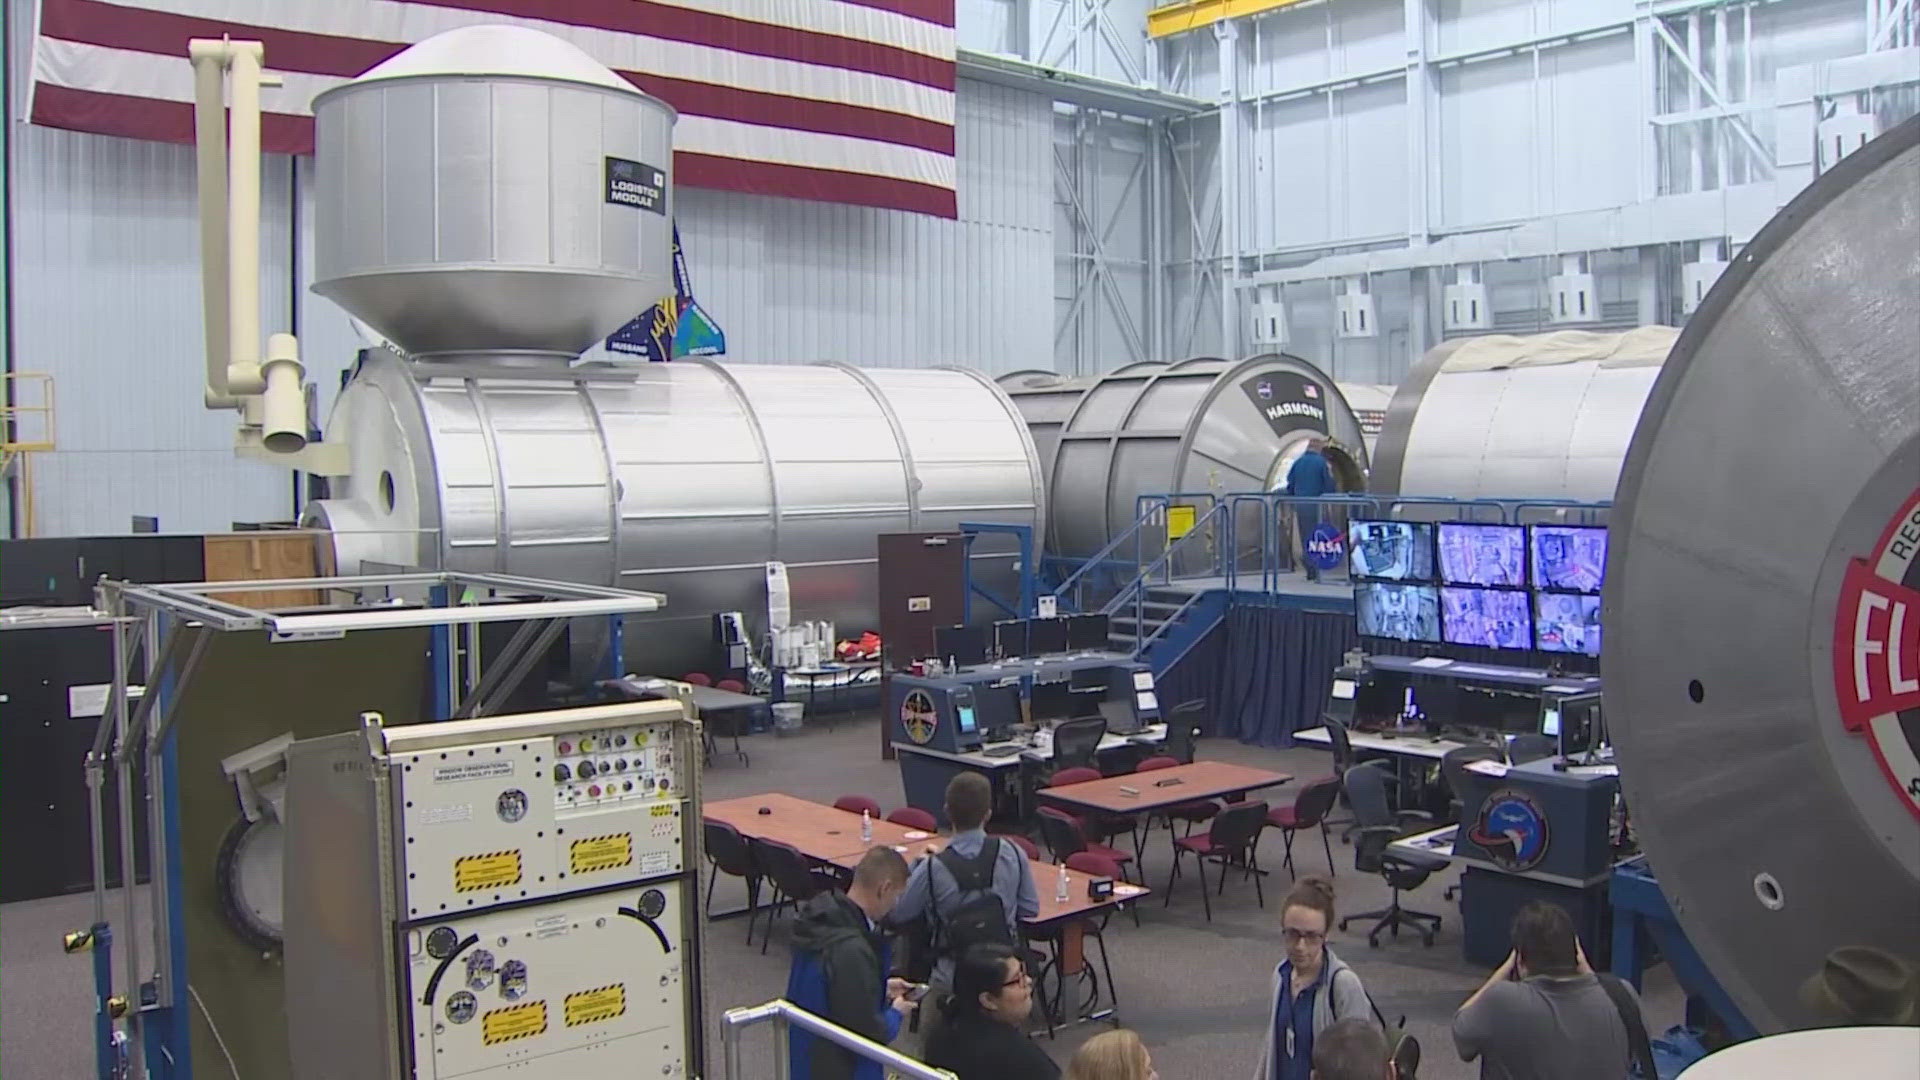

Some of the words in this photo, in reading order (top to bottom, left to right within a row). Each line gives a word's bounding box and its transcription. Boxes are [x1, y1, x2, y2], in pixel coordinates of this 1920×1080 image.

[611, 180, 658, 199] LOGISTICS
[611, 191, 653, 207] MODULE
[1266, 402, 1324, 420] HARMONY
[1308, 540, 1343, 554] NASA
[1853, 589, 1920, 702] FL
